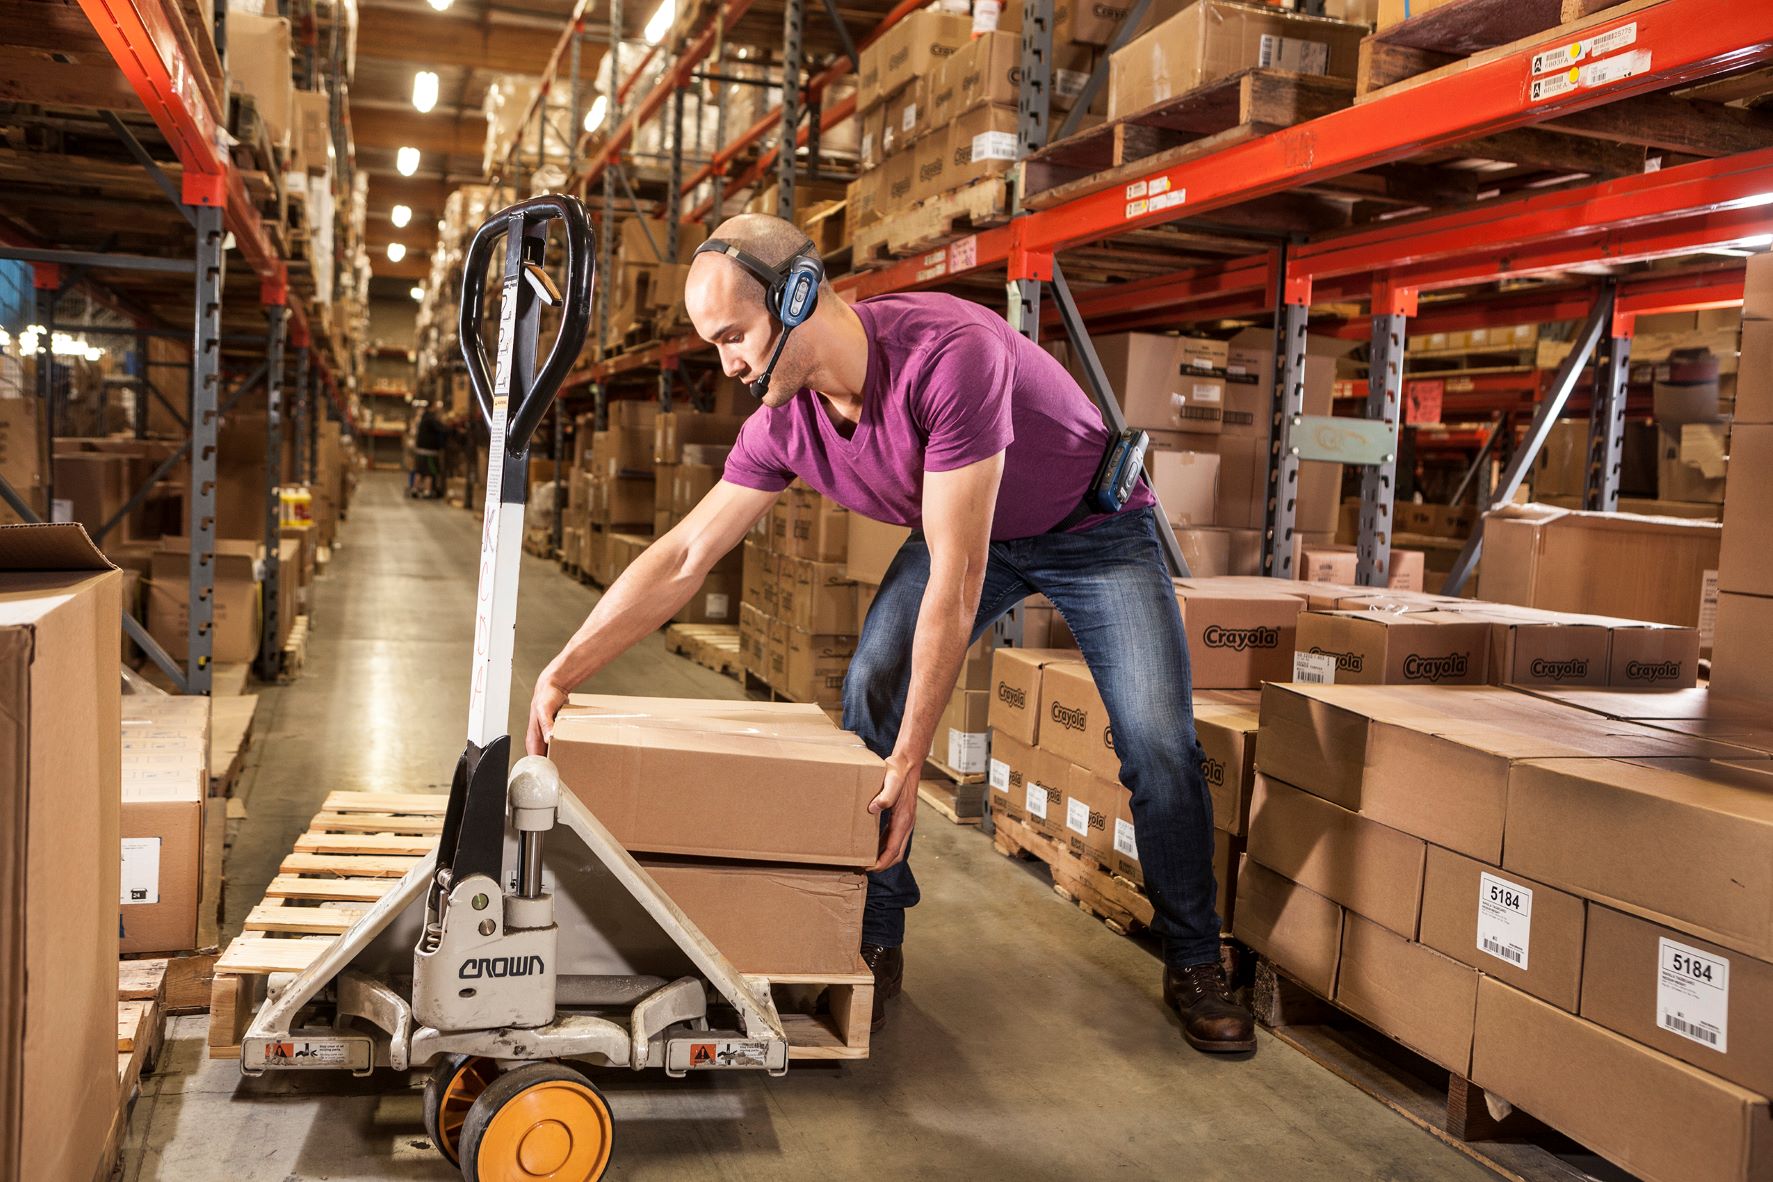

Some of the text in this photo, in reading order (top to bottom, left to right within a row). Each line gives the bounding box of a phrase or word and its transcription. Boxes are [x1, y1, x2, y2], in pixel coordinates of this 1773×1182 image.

[1203, 625, 1279, 651] Crayola
[1403, 654, 1468, 680] Crayola
[1530, 658, 1588, 680] Crayola
[1626, 661, 1680, 681] Crayola
[999, 681, 1026, 709] Crayola
[1052, 701, 1087, 731] Crayola
[1491, 885, 1520, 910] 5184
[458, 955, 545, 979] CROWN
[1673, 953, 1713, 982] 5184
